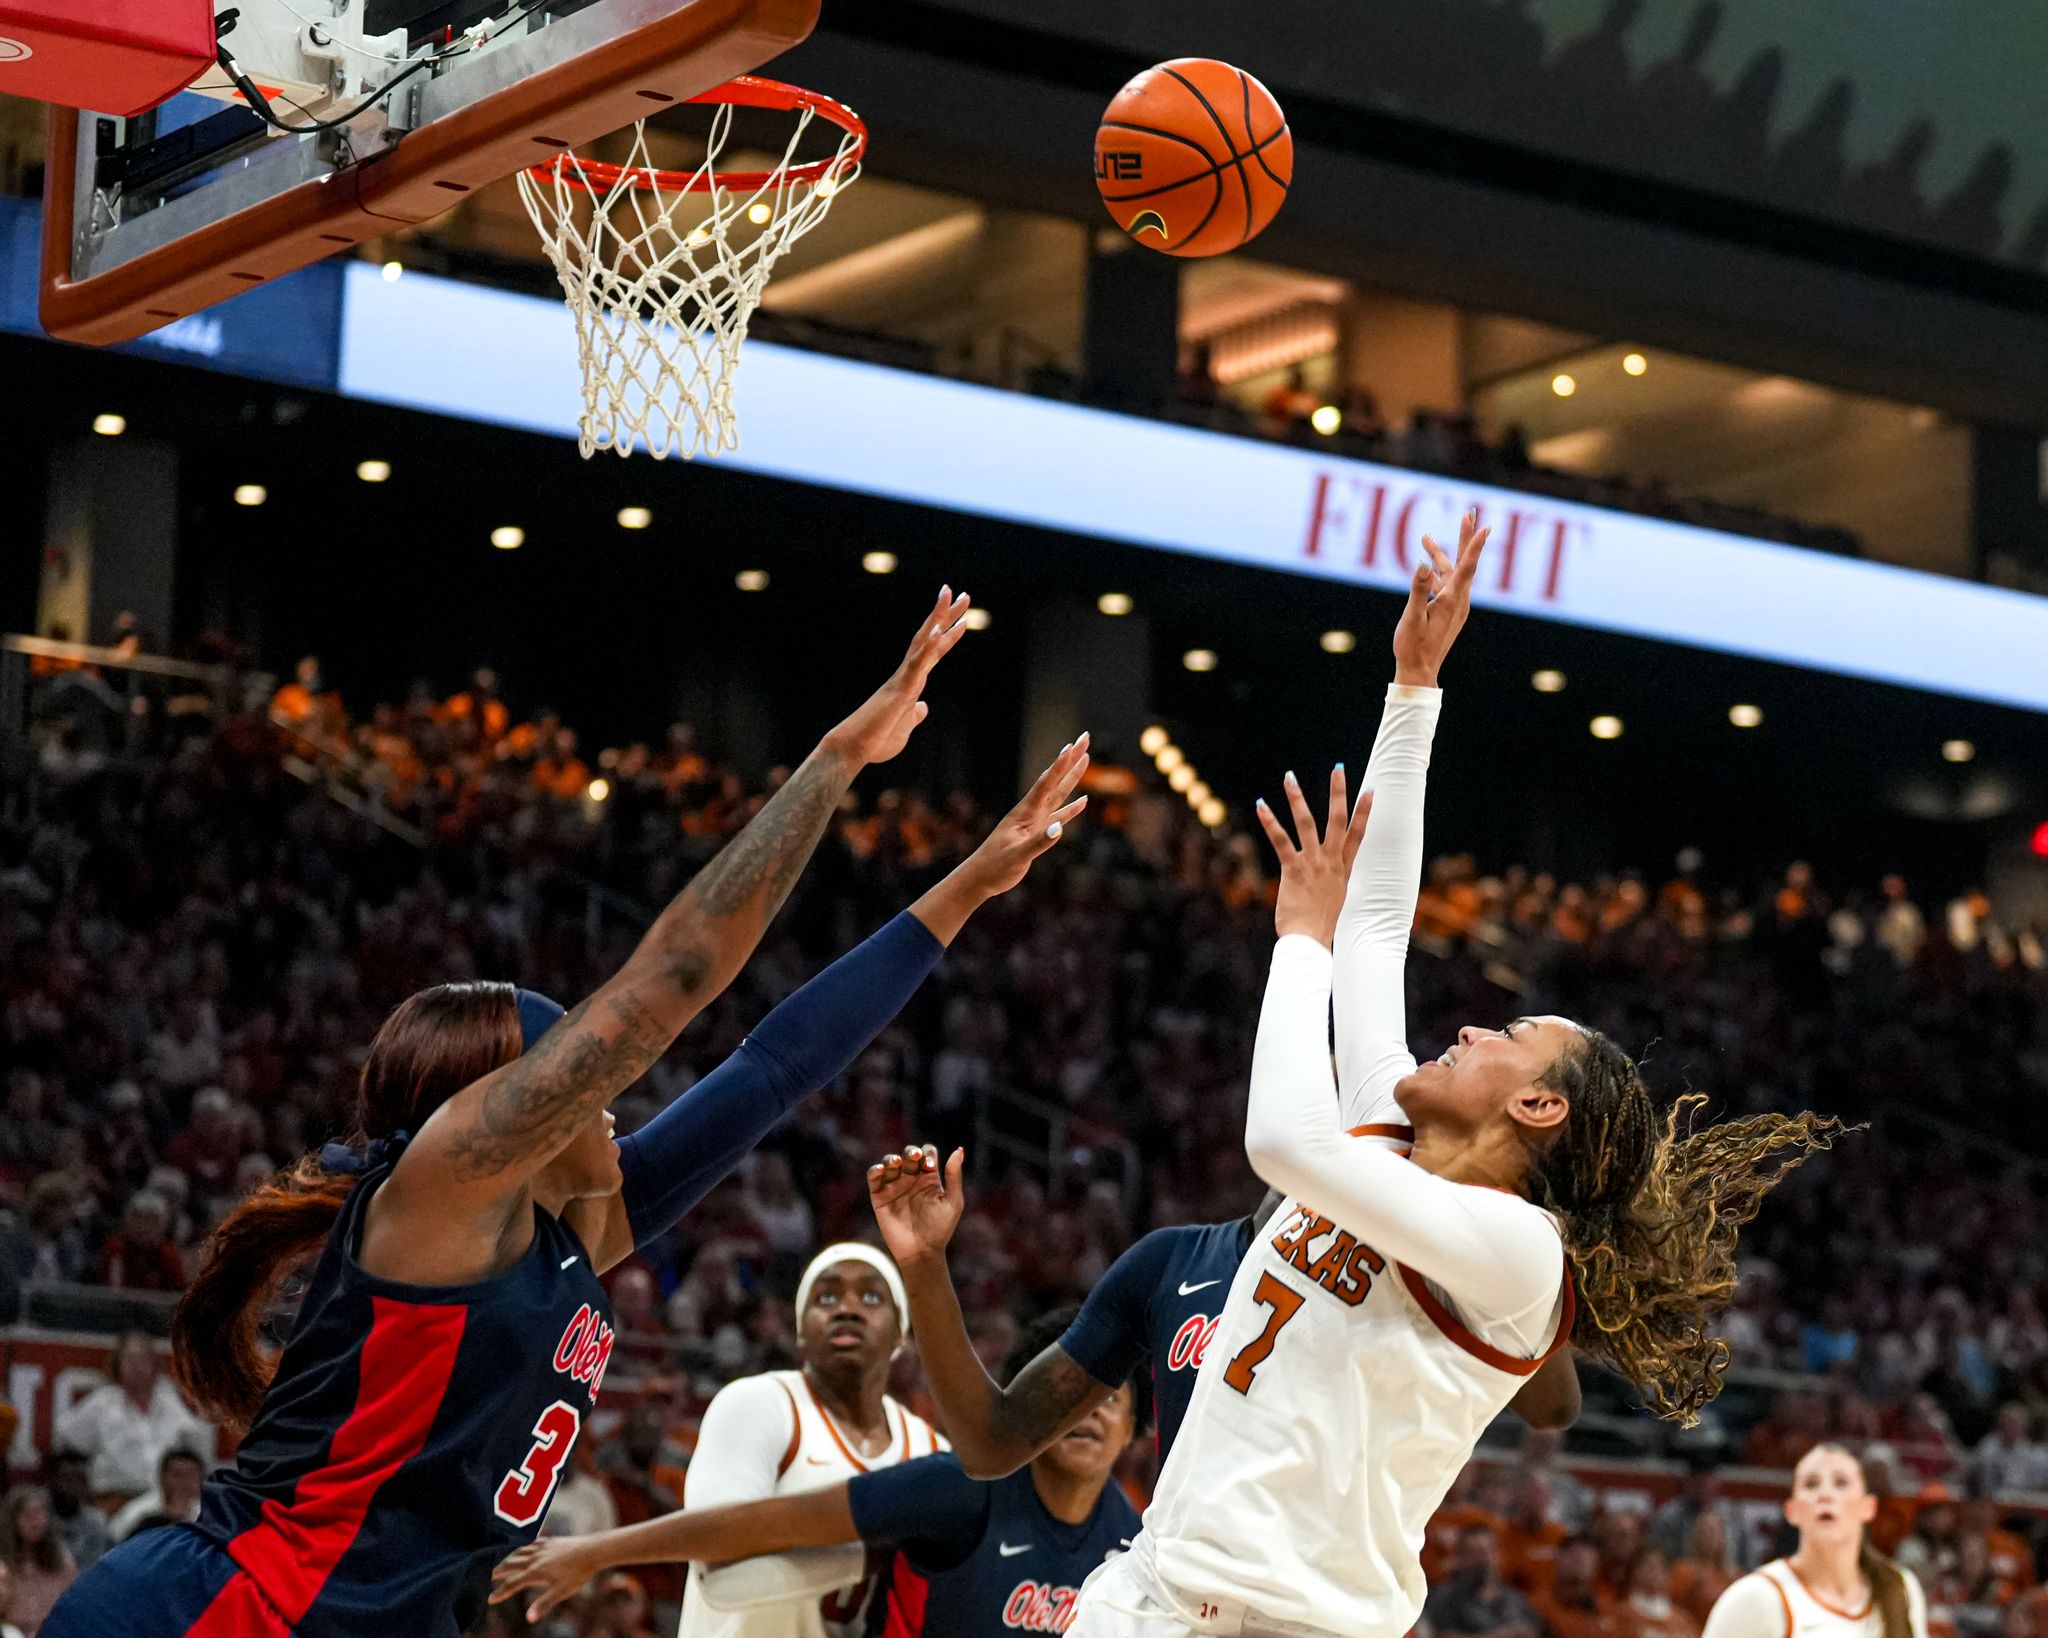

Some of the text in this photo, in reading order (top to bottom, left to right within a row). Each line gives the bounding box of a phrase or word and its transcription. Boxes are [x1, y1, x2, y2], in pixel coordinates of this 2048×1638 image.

[1268, 1204, 1386, 1307] EXAS
[553, 1302, 600, 1383] Ole
[1222, 1267, 1306, 1396] 7
[494, 1399, 580, 1528] 3
[1002, 1579, 1053, 1632] Ole
